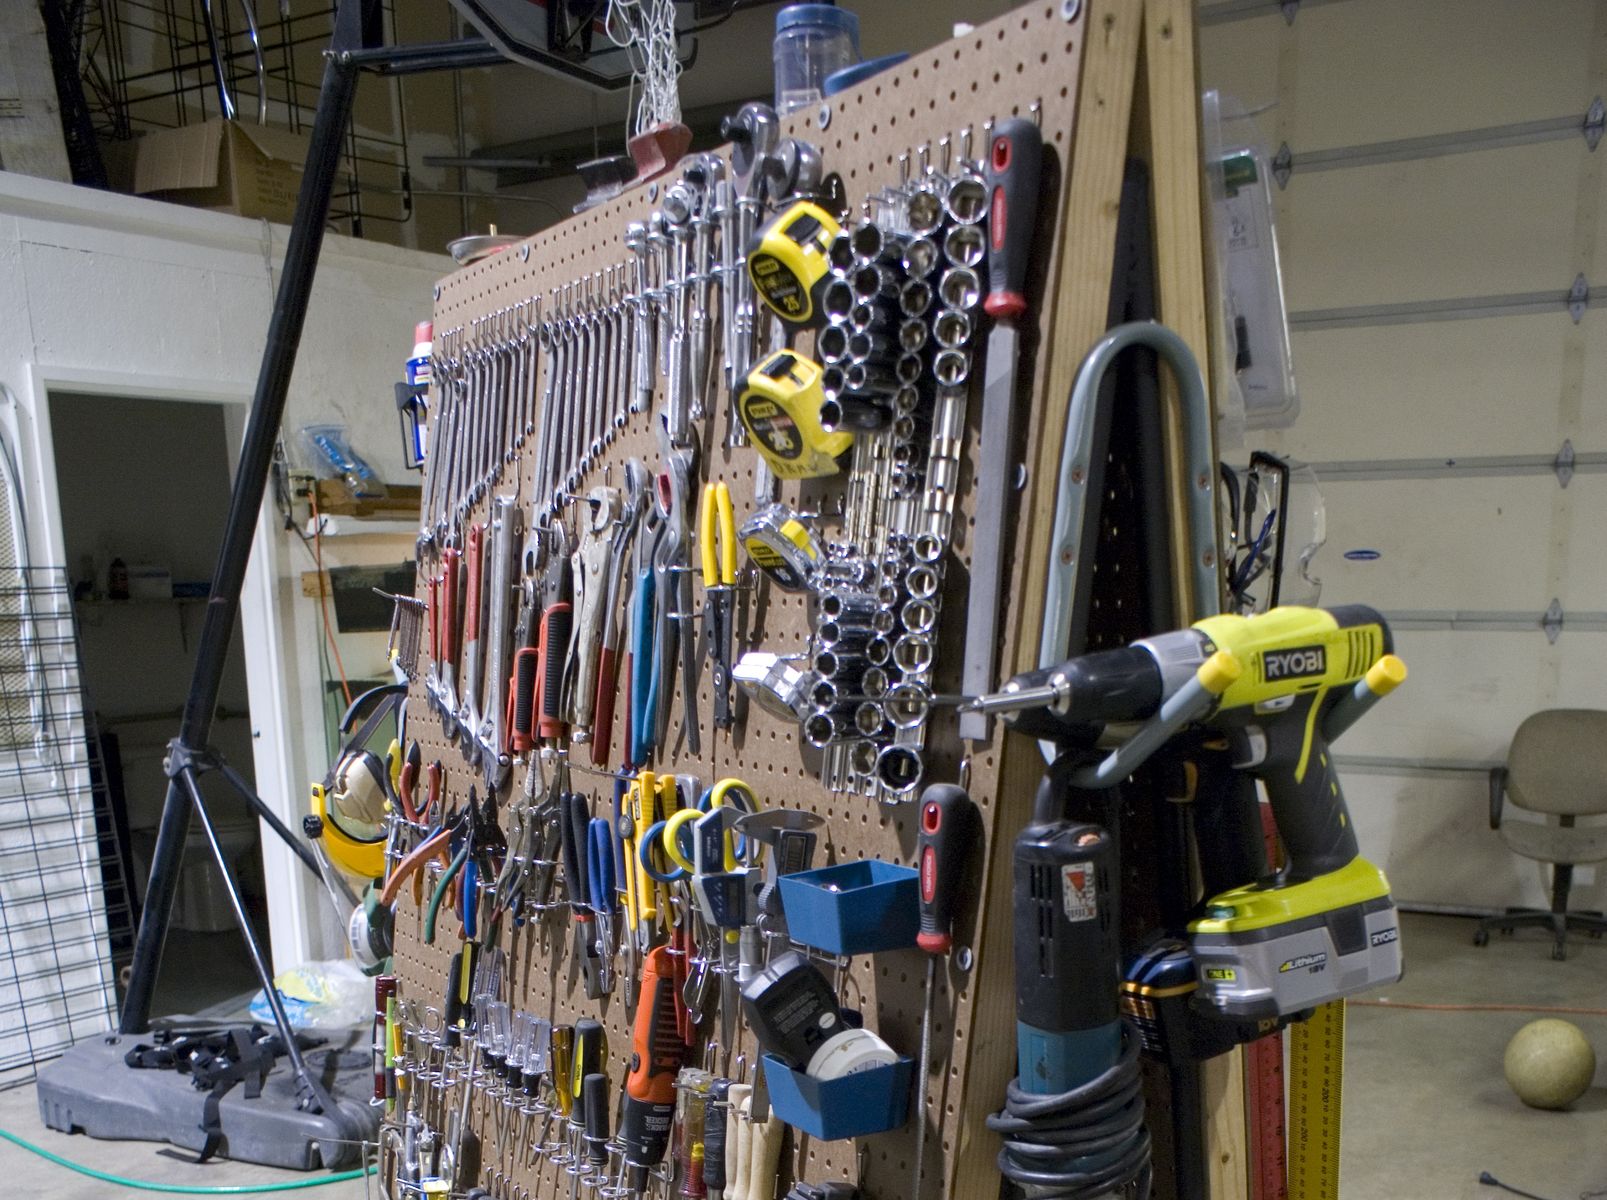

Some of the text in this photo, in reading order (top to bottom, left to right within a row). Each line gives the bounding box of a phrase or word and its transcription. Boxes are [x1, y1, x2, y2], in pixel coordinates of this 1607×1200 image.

[783, 295, 800, 311] 25
[1265, 649, 1323, 678] RYOBI
[1372, 929, 1398, 945] RYOBI
[1289, 953, 1326, 969] Lithium
